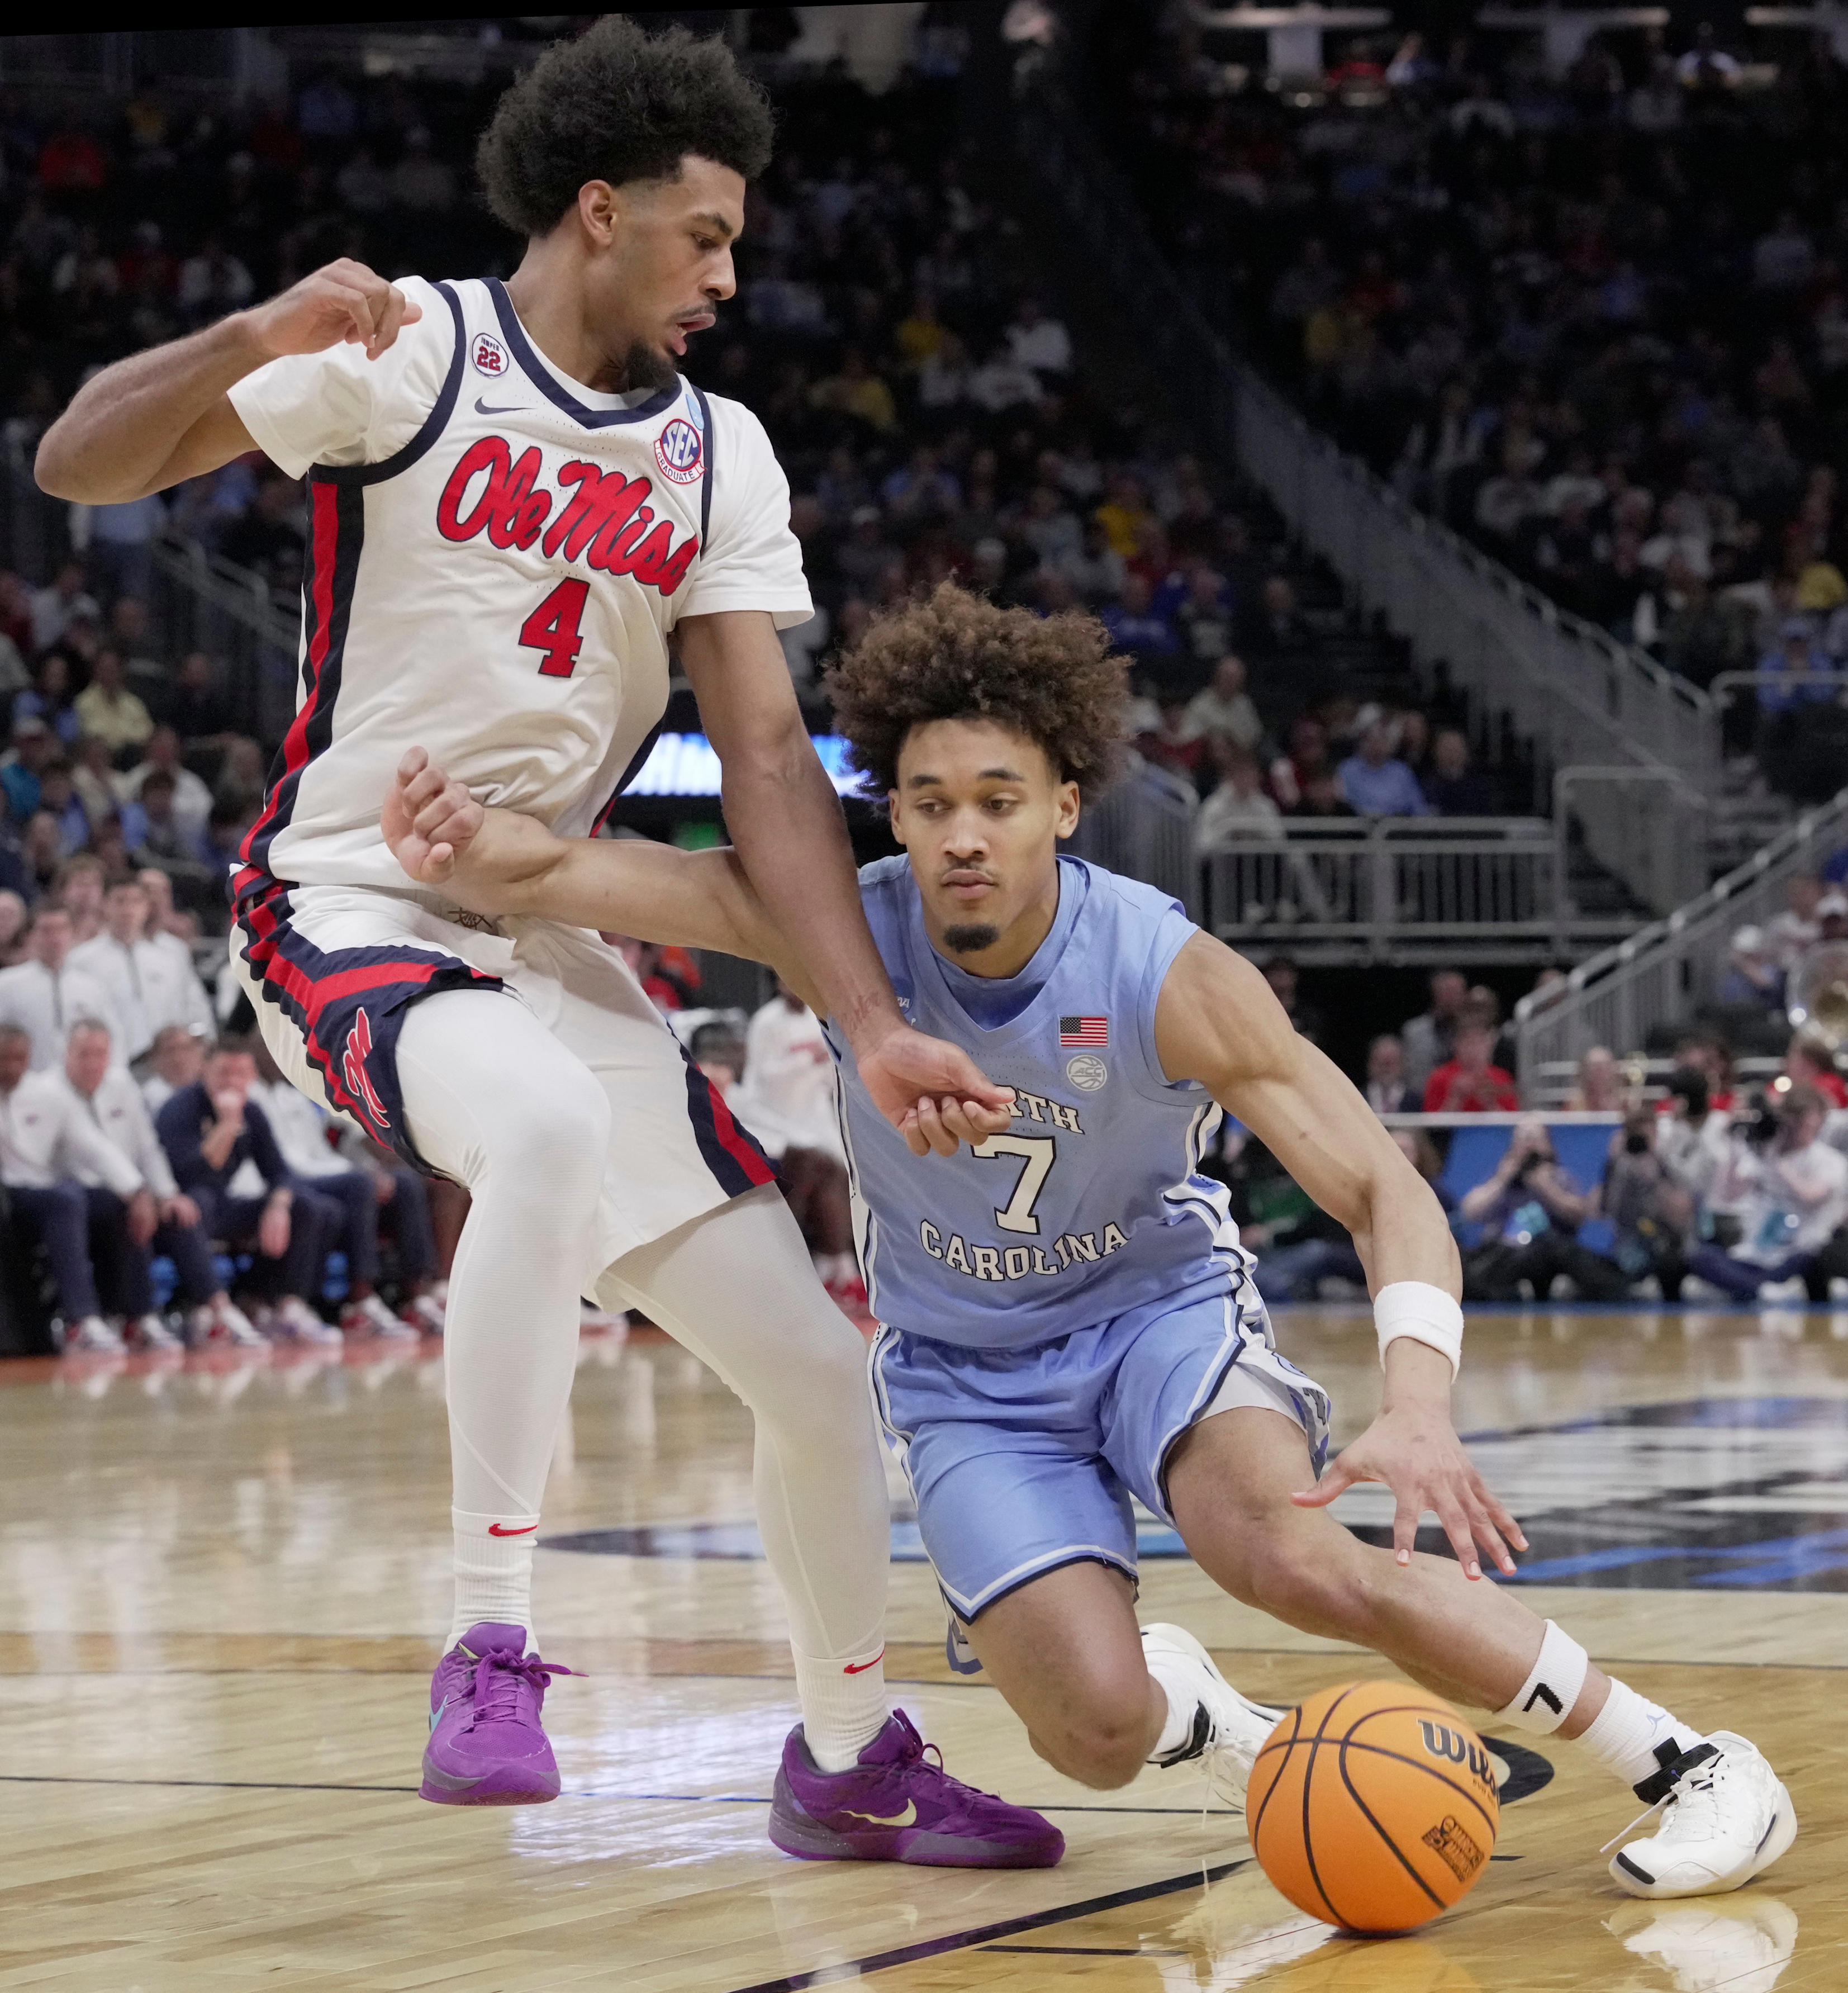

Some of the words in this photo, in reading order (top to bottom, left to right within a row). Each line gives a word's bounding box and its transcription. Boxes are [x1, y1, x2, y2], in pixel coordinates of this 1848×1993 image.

[477, 345, 501, 372] 22
[657, 452, 695, 482] GRADUATE
[663, 421, 698, 468] SEC
[437, 435, 552, 552] Ole
[542, 459, 700, 596] Miss
[518, 576, 591, 678] 4
[992, 1083, 1086, 1135] RTH
[971, 1132, 1057, 1235] 7
[920, 1219, 1132, 1282] CAROLINA
[1522, 1682, 1564, 1715] 7
